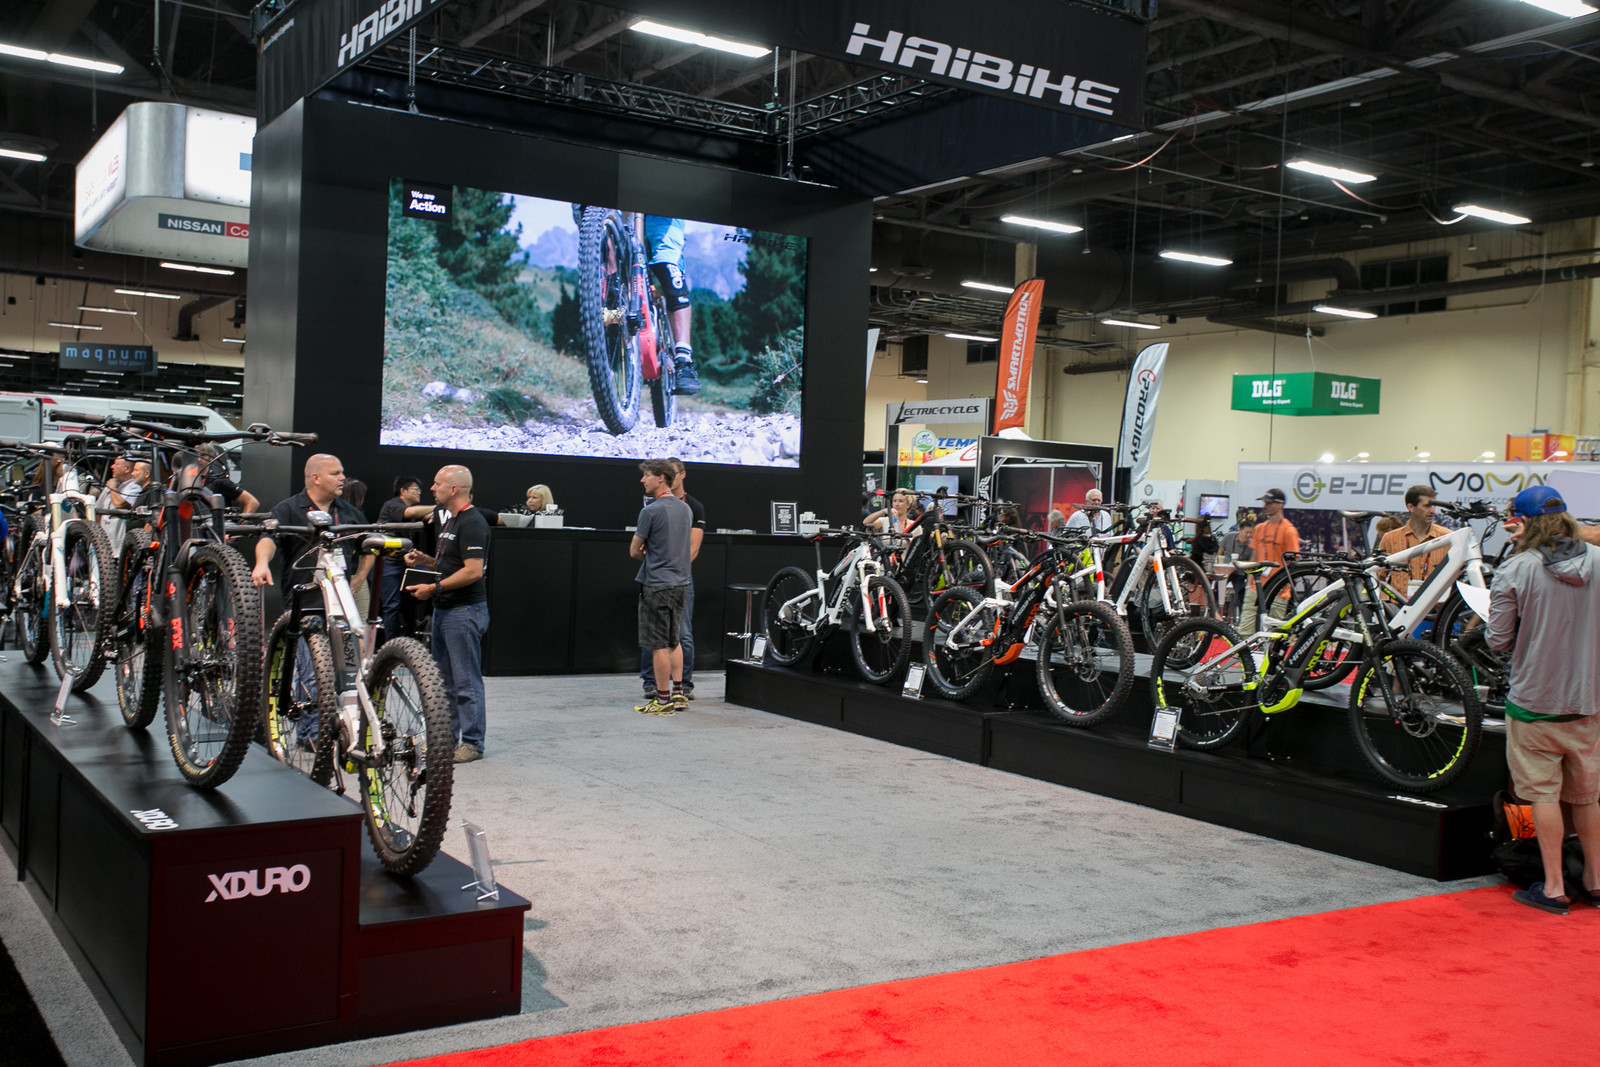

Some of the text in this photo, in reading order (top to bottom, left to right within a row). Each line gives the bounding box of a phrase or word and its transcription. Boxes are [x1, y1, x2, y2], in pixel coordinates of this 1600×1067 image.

[845, 22, 1120, 116] HAIBIKE
[410, 190, 423, 199] We
[409, 199, 446, 214] Action
[167, 218, 250, 237] NISSAN Co
[1006, 291, 1030, 391] SMARTMOTION
[65, 347, 147, 362] magnum
[1251, 380, 1283, 398] DLG
[1331, 381, 1357, 400] DLG
[1130, 377, 1151, 463] PRODIGY
[1328, 474, 1408, 496] e-JOE
[1429, 472, 1548, 493] MOMA
[204, 863, 312, 903] XDURO
